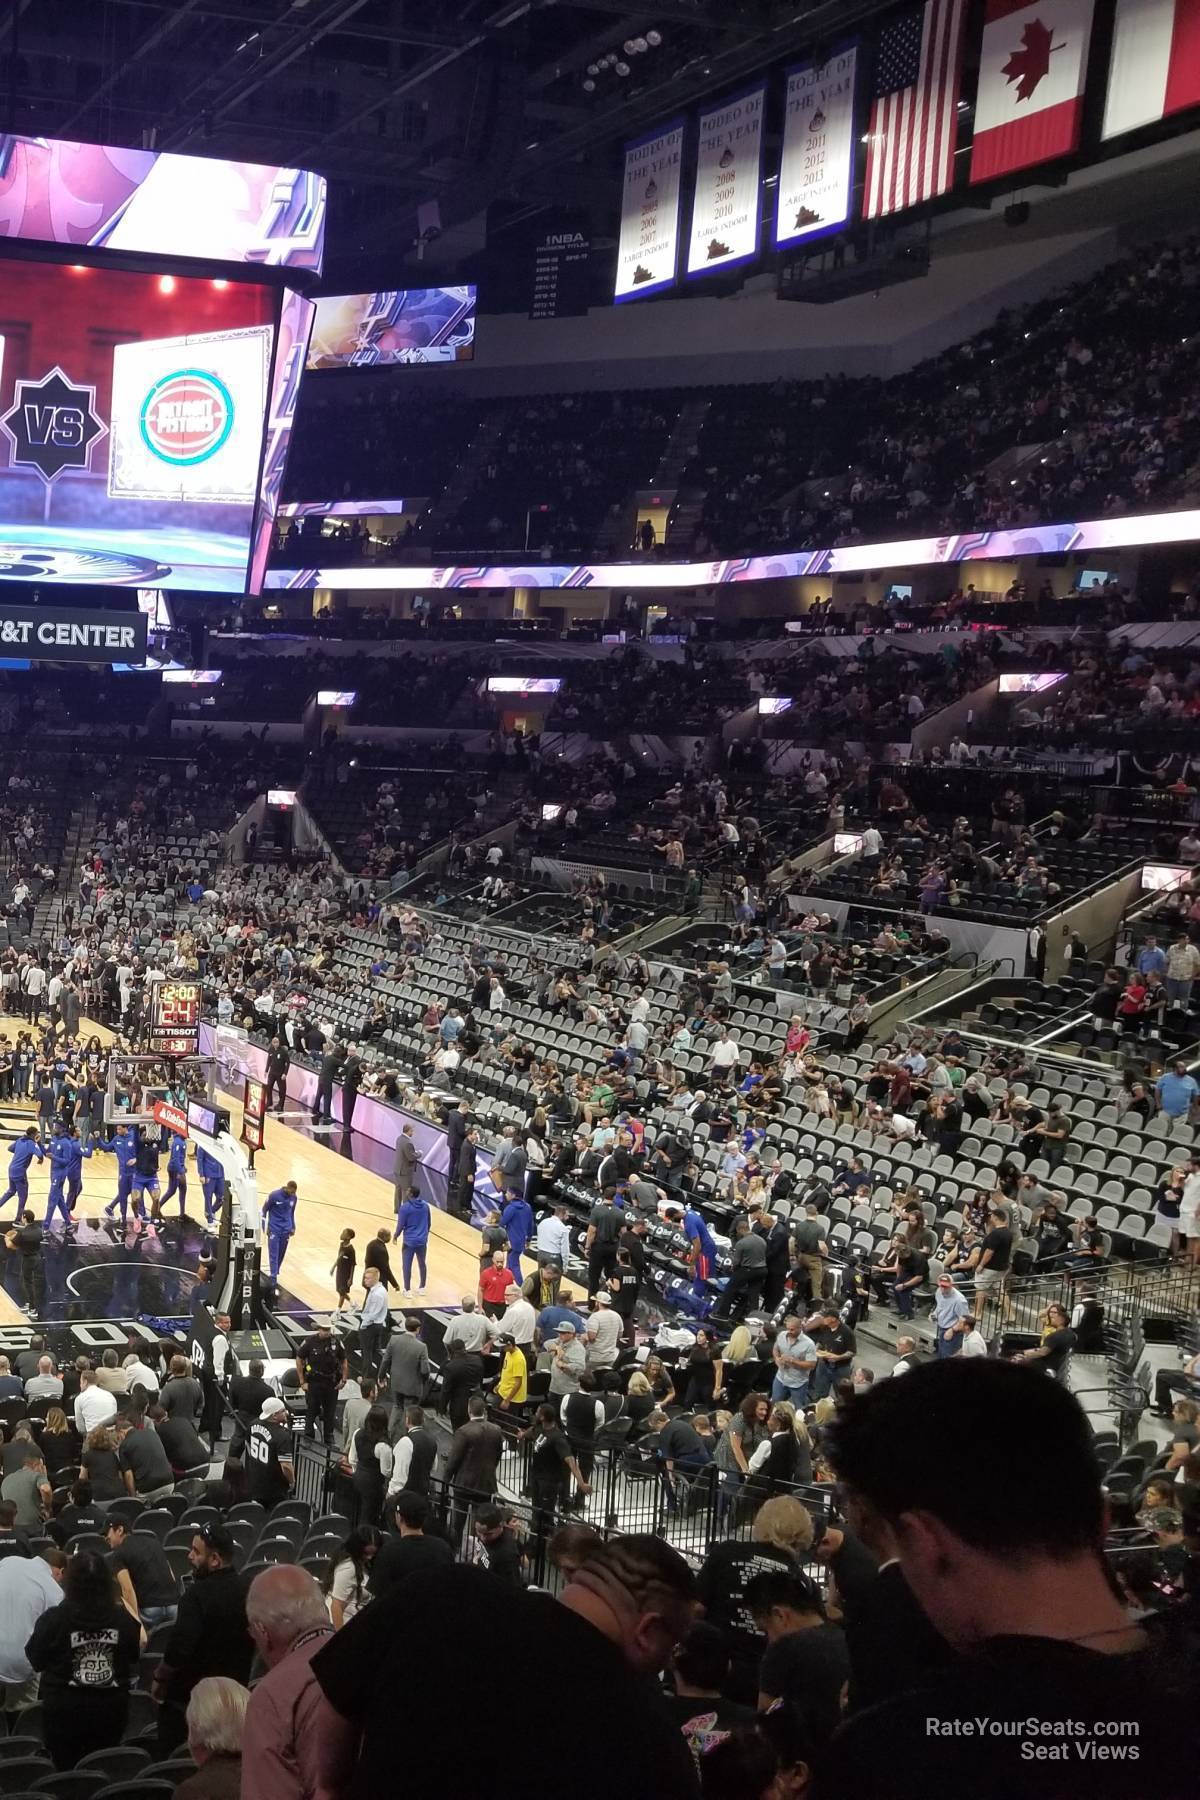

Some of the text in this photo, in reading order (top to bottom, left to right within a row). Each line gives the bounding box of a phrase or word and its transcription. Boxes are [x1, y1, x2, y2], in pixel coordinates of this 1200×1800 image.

[821, 79, 850, 101] YEAR
[728, 120, 759, 142] YEAR
[628, 138, 665, 164] RODEO
[806, 134, 826, 151] 2011
[804, 152, 825, 169] 2012
[628, 166, 649, 182] THE
[715, 172, 736, 187] 2008
[803, 169, 824, 187] 2013
[715, 188, 735, 203] 2009
[714, 205, 733, 220] 2010
[641, 216, 657, 231] 2006
[552, 233, 583, 244] NBA
[640, 231, 657, 246] 2007
[24, 403, 84, 447] VS
[38, 621, 135, 648] CENTER
[159, 986, 196, 1001] 12:00
[162, 1001, 191, 1024] 24
[166, 1028, 197, 1036] TISSOT
[241, 1270, 253, 1314] NBA
[250, 1435, 269, 1464] 50
